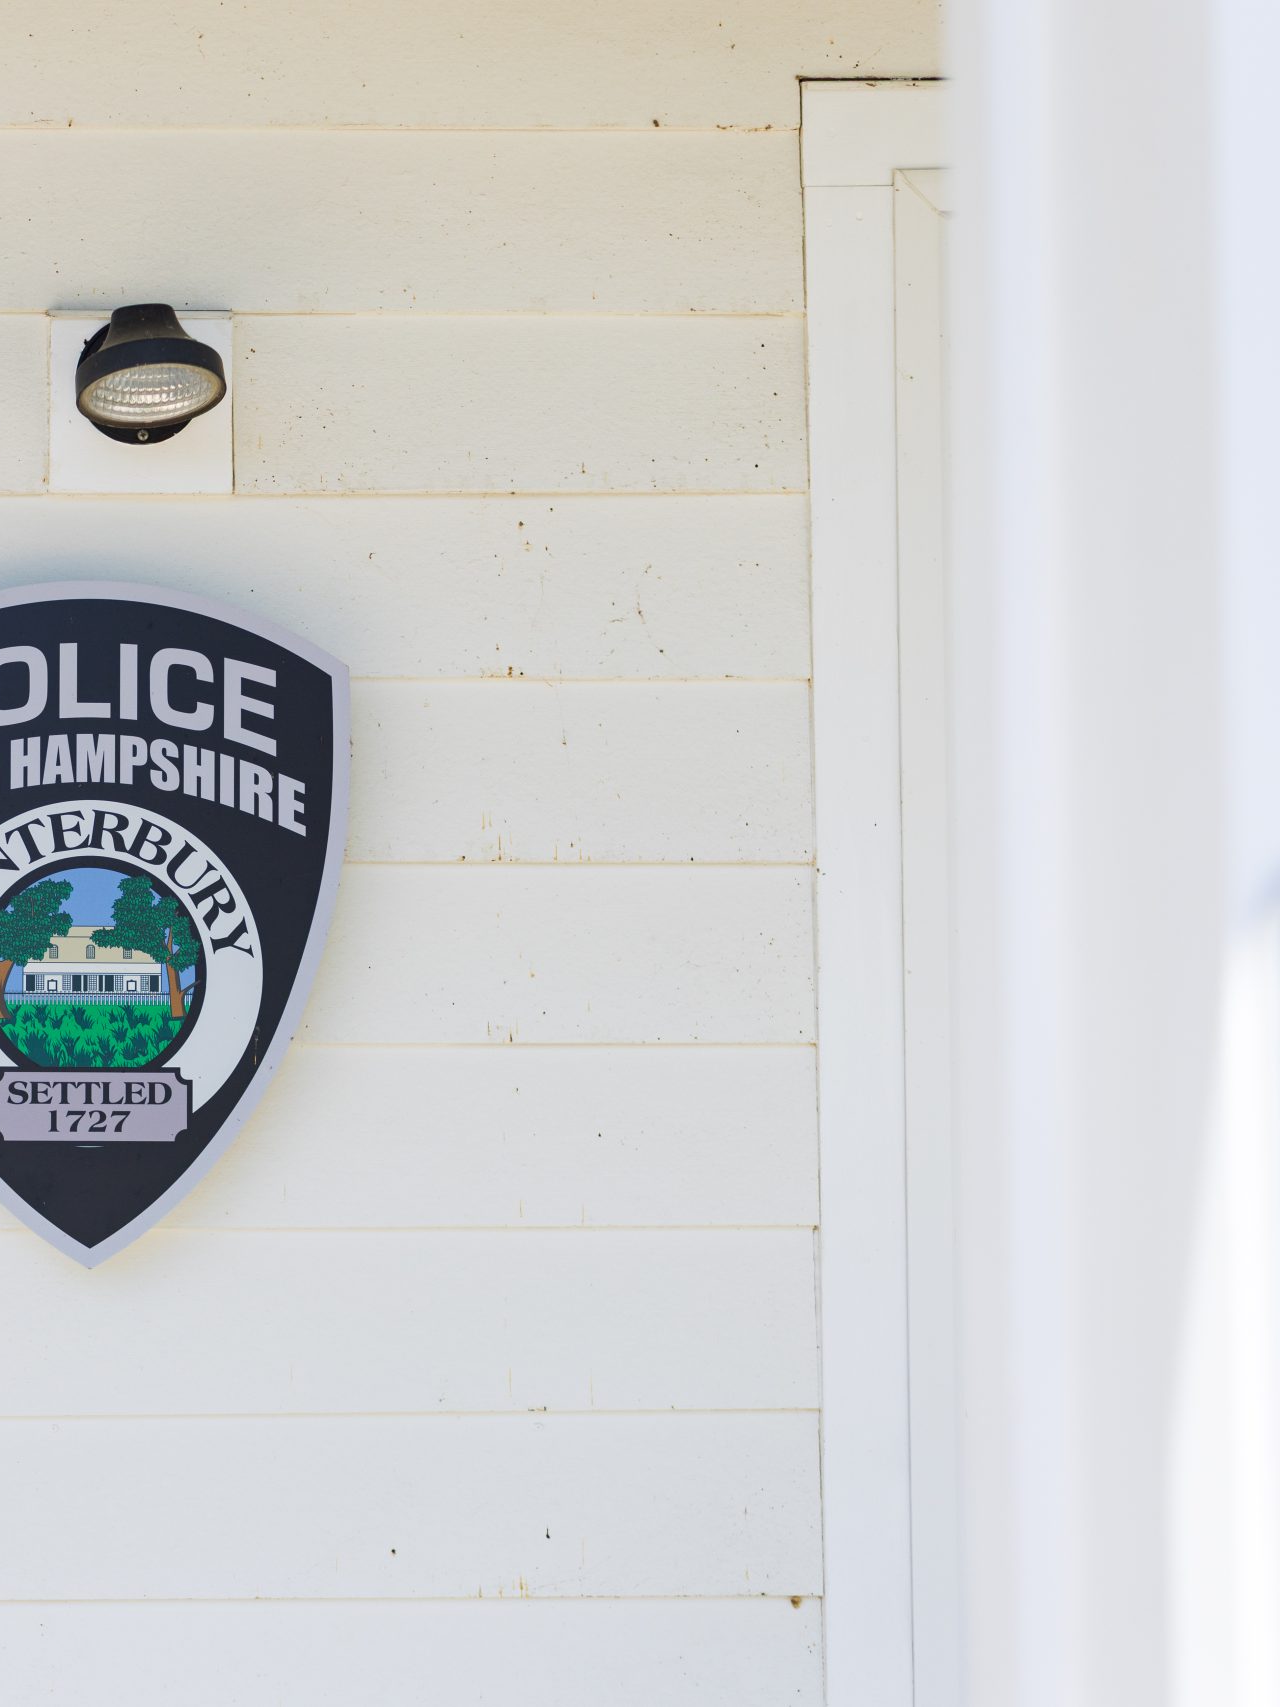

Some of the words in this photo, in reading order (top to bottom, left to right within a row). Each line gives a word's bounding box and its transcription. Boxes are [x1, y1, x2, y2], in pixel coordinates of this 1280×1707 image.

[10, 733, 308, 837] HAMPSHIRE
[6, 1080, 173, 1106] SETTLED
[47, 1110, 132, 1133] 1727
